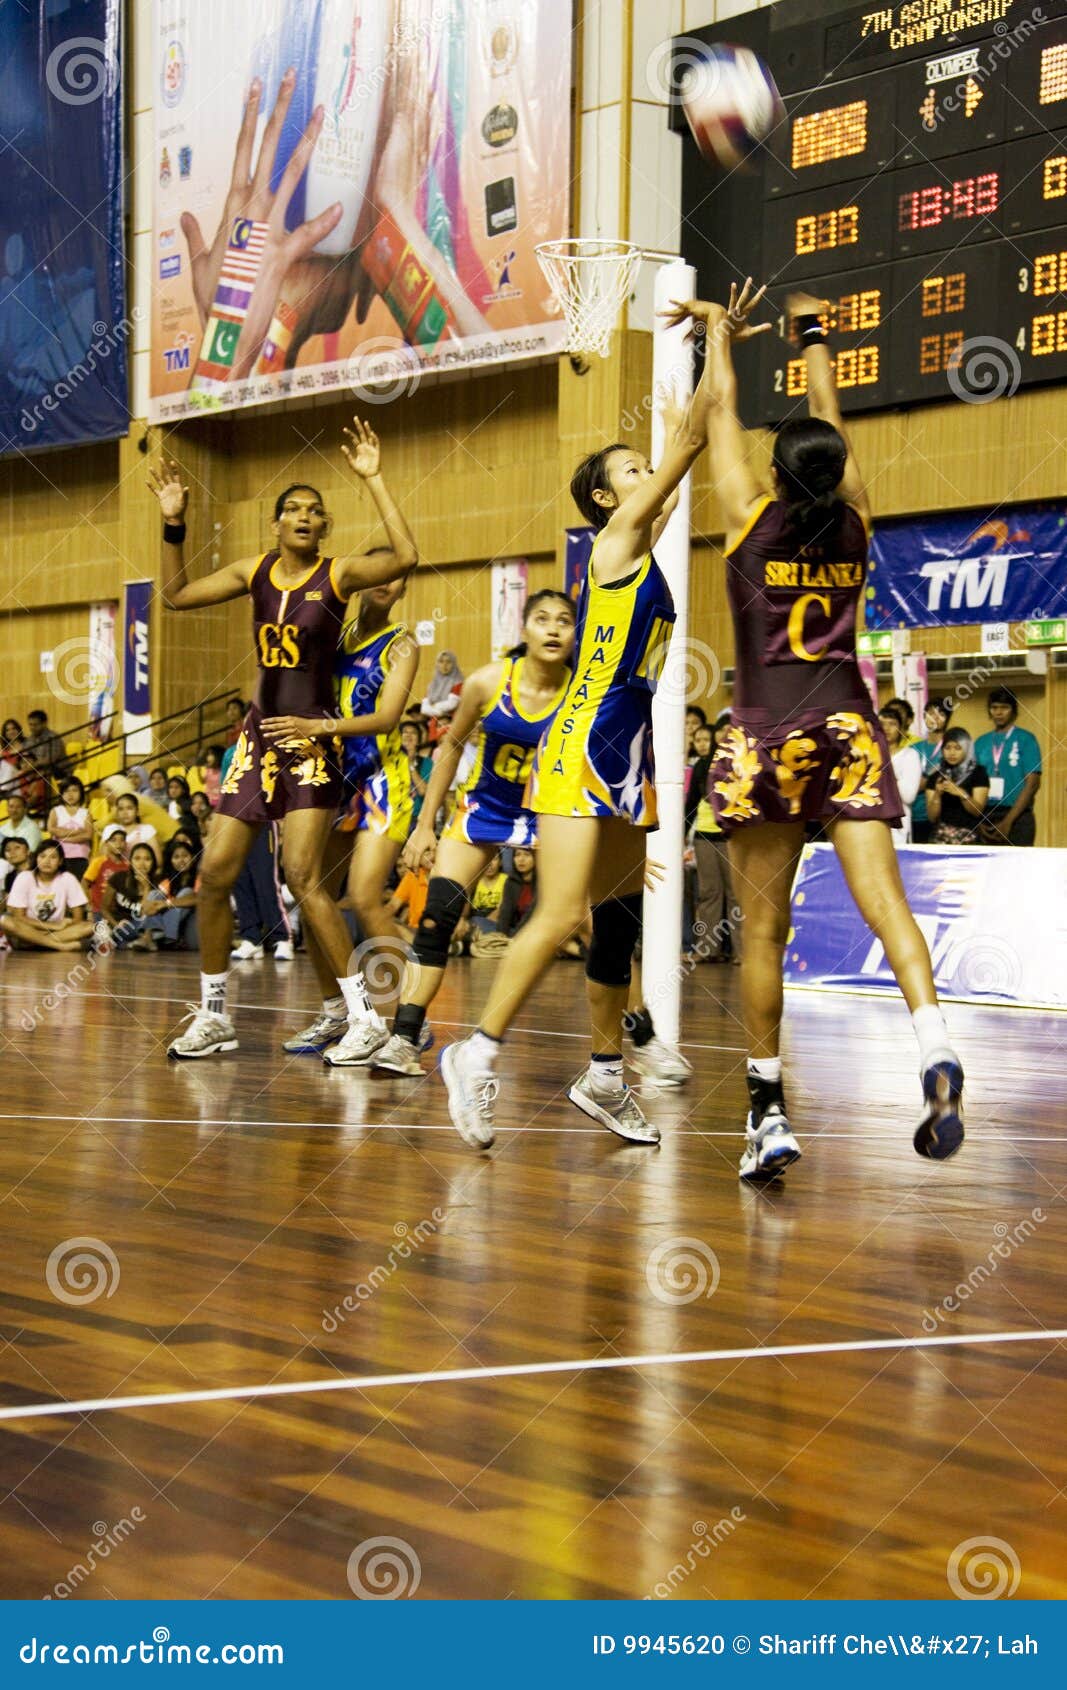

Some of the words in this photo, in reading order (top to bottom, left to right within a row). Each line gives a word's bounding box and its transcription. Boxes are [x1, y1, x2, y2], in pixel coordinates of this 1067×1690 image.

[861, 9, 892, 37] 7TH
[900, 0, 951, 26] ASIAN
[890, 0, 1013, 49] CHAMPIONSHIP
[926, 54, 978, 80] OLYMPEX
[1018, 267, 1028, 293] 3
[777, 315, 785, 337] 1
[1016, 327, 1026, 351] 4
[163, 347, 190, 372] TM
[774, 369, 784, 392] 2
[764, 561, 799, 586] SRI
[801, 561, 862, 588] LANKA
[920, 556, 1010, 611] TM
[787, 593, 831, 662] C
[135, 618, 149, 692] TM
[259, 623, 300, 668] GS
[551, 625, 615, 776] MALAYSIA
